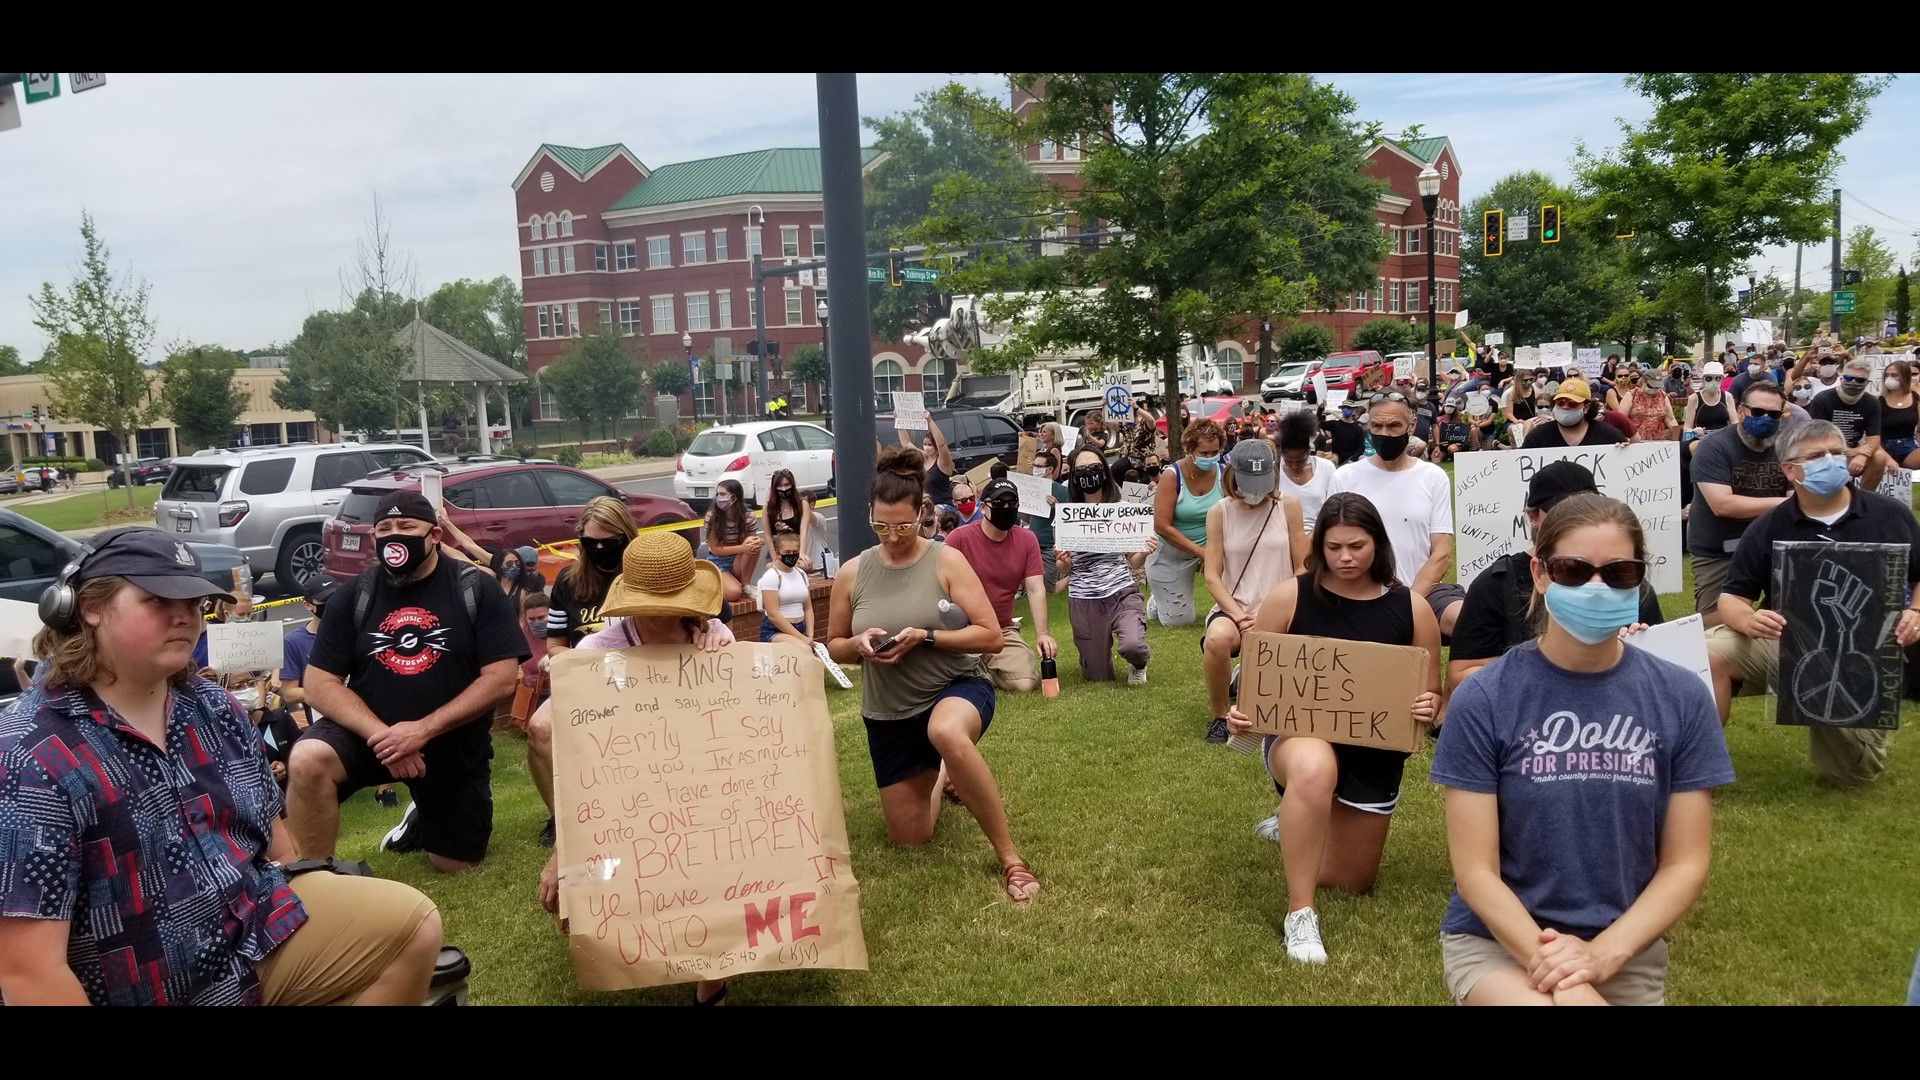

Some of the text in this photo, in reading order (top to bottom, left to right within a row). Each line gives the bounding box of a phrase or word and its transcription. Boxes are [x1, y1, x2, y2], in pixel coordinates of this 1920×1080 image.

[1105, 375, 1128, 385] LOVE
[1110, 395, 1126, 403] NOT
[1107, 411, 1130, 420] HATE
[1445, 433, 1466, 443] listening
[1446, 423, 1461, 432] I'm
[1516, 453, 1606, 483] BLK
[1624, 444, 1676, 482] DONATE
[1080, 474, 1101, 488] BLM
[1457, 459, 1500, 497] JUSTICE
[1732, 475, 1785, 490] WARS
[1624, 486, 1677, 506] PROTEST
[1061, 506, 1154, 521] SPEAK UP BECAUSE
[1466, 502, 1501, 517] PEACE
[1079, 521, 1149, 535] THEY CAN'T
[1639, 515, 1673, 531] OTE
[1461, 524, 1499, 546] UNITY
[1461, 536, 1513, 577] STRENGTH
[397, 615, 423, 624] MUSIC
[215, 627, 232, 641] I
[232, 641, 253, 650] my
[216, 650, 266, 660] blackness
[390, 654, 428, 666] EXTREME
[1256, 640, 1352, 675] BLACK
[647, 665, 672, 685] the
[678, 653, 734, 690] KING
[751, 655, 801, 685] shall
[1257, 671, 1355, 702] LIVES
[1877, 666, 1900, 729] BLACK
[570, 689, 798, 727] answer and say unto them,
[1256, 703, 1389, 741] MATTER
[588, 716, 681, 760] Verily
[701, 708, 728, 741] I
[1533, 711, 1656, 765] Dolly
[1521, 752, 1655, 776] FOR PRESIDEN
[1558, 772, 1589, 782] country
[1589, 772, 1613, 780] music
[1613, 773, 1633, 784] great
[577, 764, 783, 824] as ye have done it
[593, 795, 806, 845] unto ONE of these
[632, 811, 820, 880] BRETHREN
[588, 854, 838, 941] ye have done IT
[617, 914, 708, 966] UNTO
[664, 942, 819, 977] MATTHEW 25:40 (KJV)
